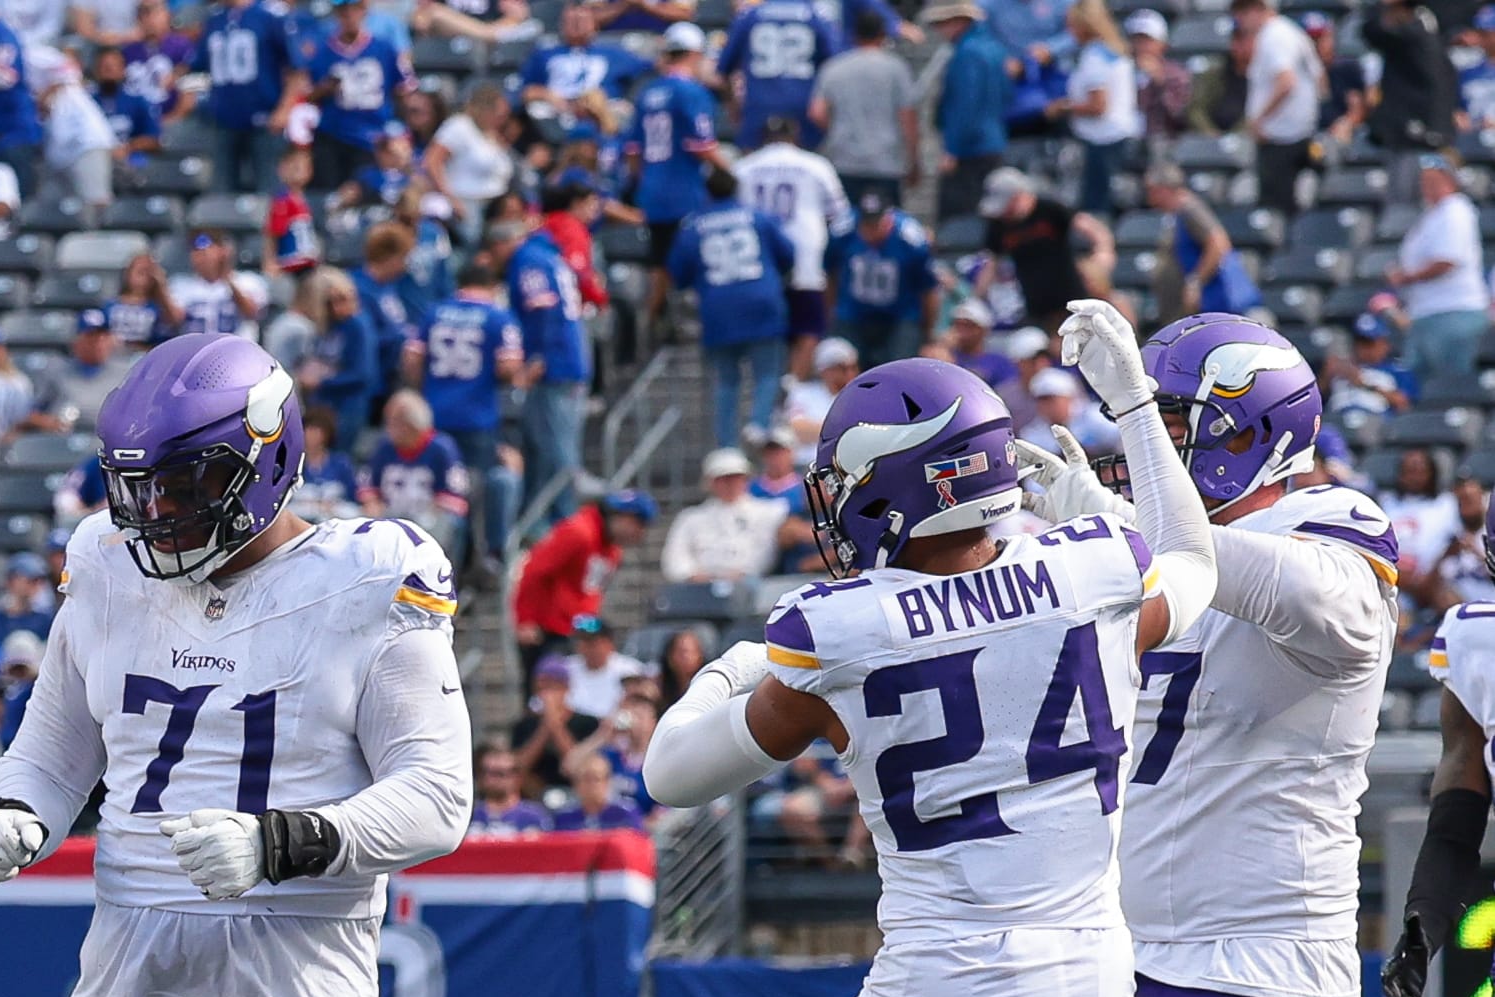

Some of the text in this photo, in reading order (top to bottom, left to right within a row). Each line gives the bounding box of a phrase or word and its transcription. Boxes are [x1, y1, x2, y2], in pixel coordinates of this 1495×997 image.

[208, 29, 257, 85] 10
[750, 22, 815, 79] 92
[699, 228, 763, 286] 92
[895, 559, 1061, 639] BYNUM
[122, 673, 277, 815] 71
[862, 620, 1128, 852] 24
